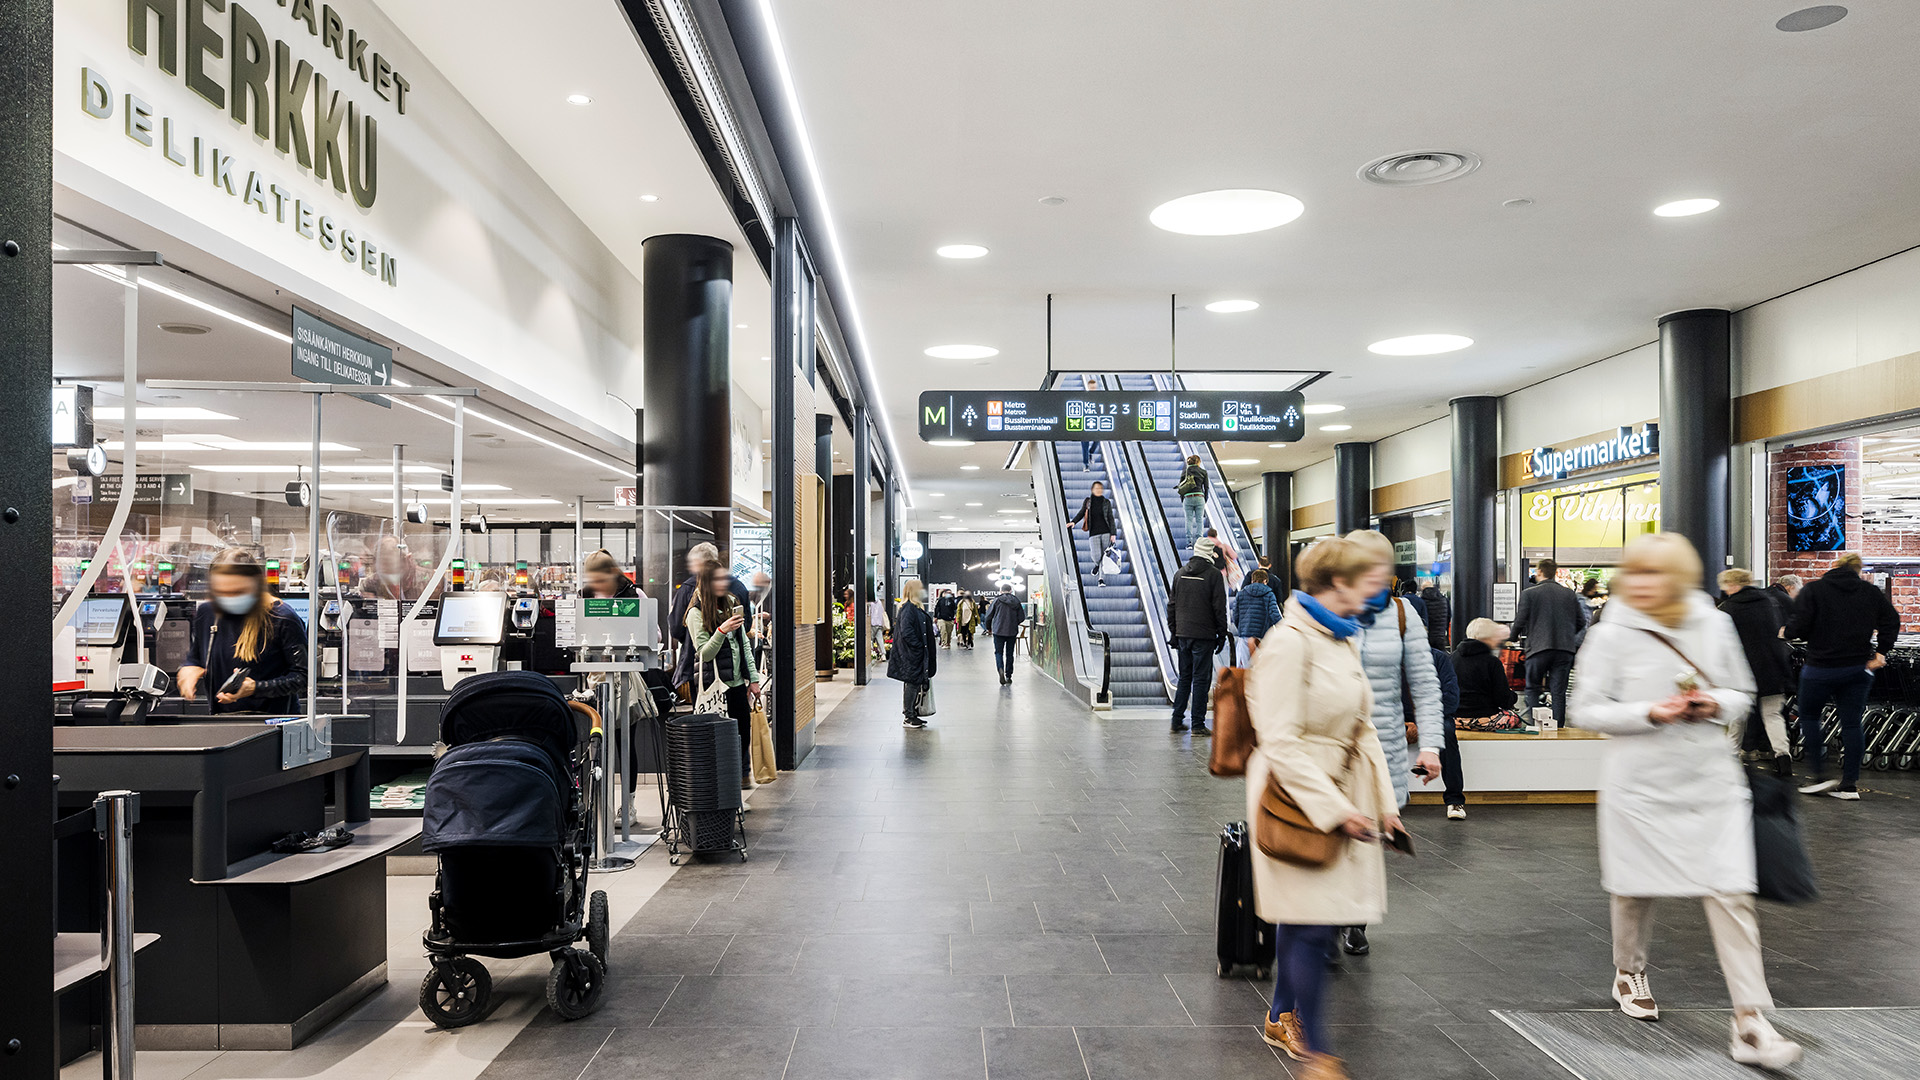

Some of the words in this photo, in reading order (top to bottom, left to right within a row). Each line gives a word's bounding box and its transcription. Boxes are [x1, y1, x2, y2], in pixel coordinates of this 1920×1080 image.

[276, 0, 411, 115] ARKET
[81, 66, 398, 287] DELIKATESSEN
[297, 326, 341, 357] SISÄÄNKÄYNTI
[341, 346, 373, 369] HERKKUUN
[297, 346, 319, 367] INGÅNG
[320, 355, 332, 372] TILL
[333, 360, 371, 386] DELIKATESSEN
[55, 401, 68, 414] A
[989, 402, 1002, 415] M
[1004, 401, 1026, 409] Metro
[1098, 404, 1104, 415] 1
[1109, 404, 1118, 415] 2
[1121, 404, 1130, 415] 3
[1179, 401, 1197, 409] H&M
[1254, 405, 1261, 415] 1
[925, 407, 946, 425] M
[1004, 416, 1058, 424] Bussiterminaali
[1179, 411, 1210, 419] Stadium
[1179, 421, 1220, 429] Stockmann
[1533, 425, 1655, 480] Supermarket
[91, 452, 98, 467] 4
[1529, 494, 1555, 522] &
[1560, 494, 1660, 521] Vihann
